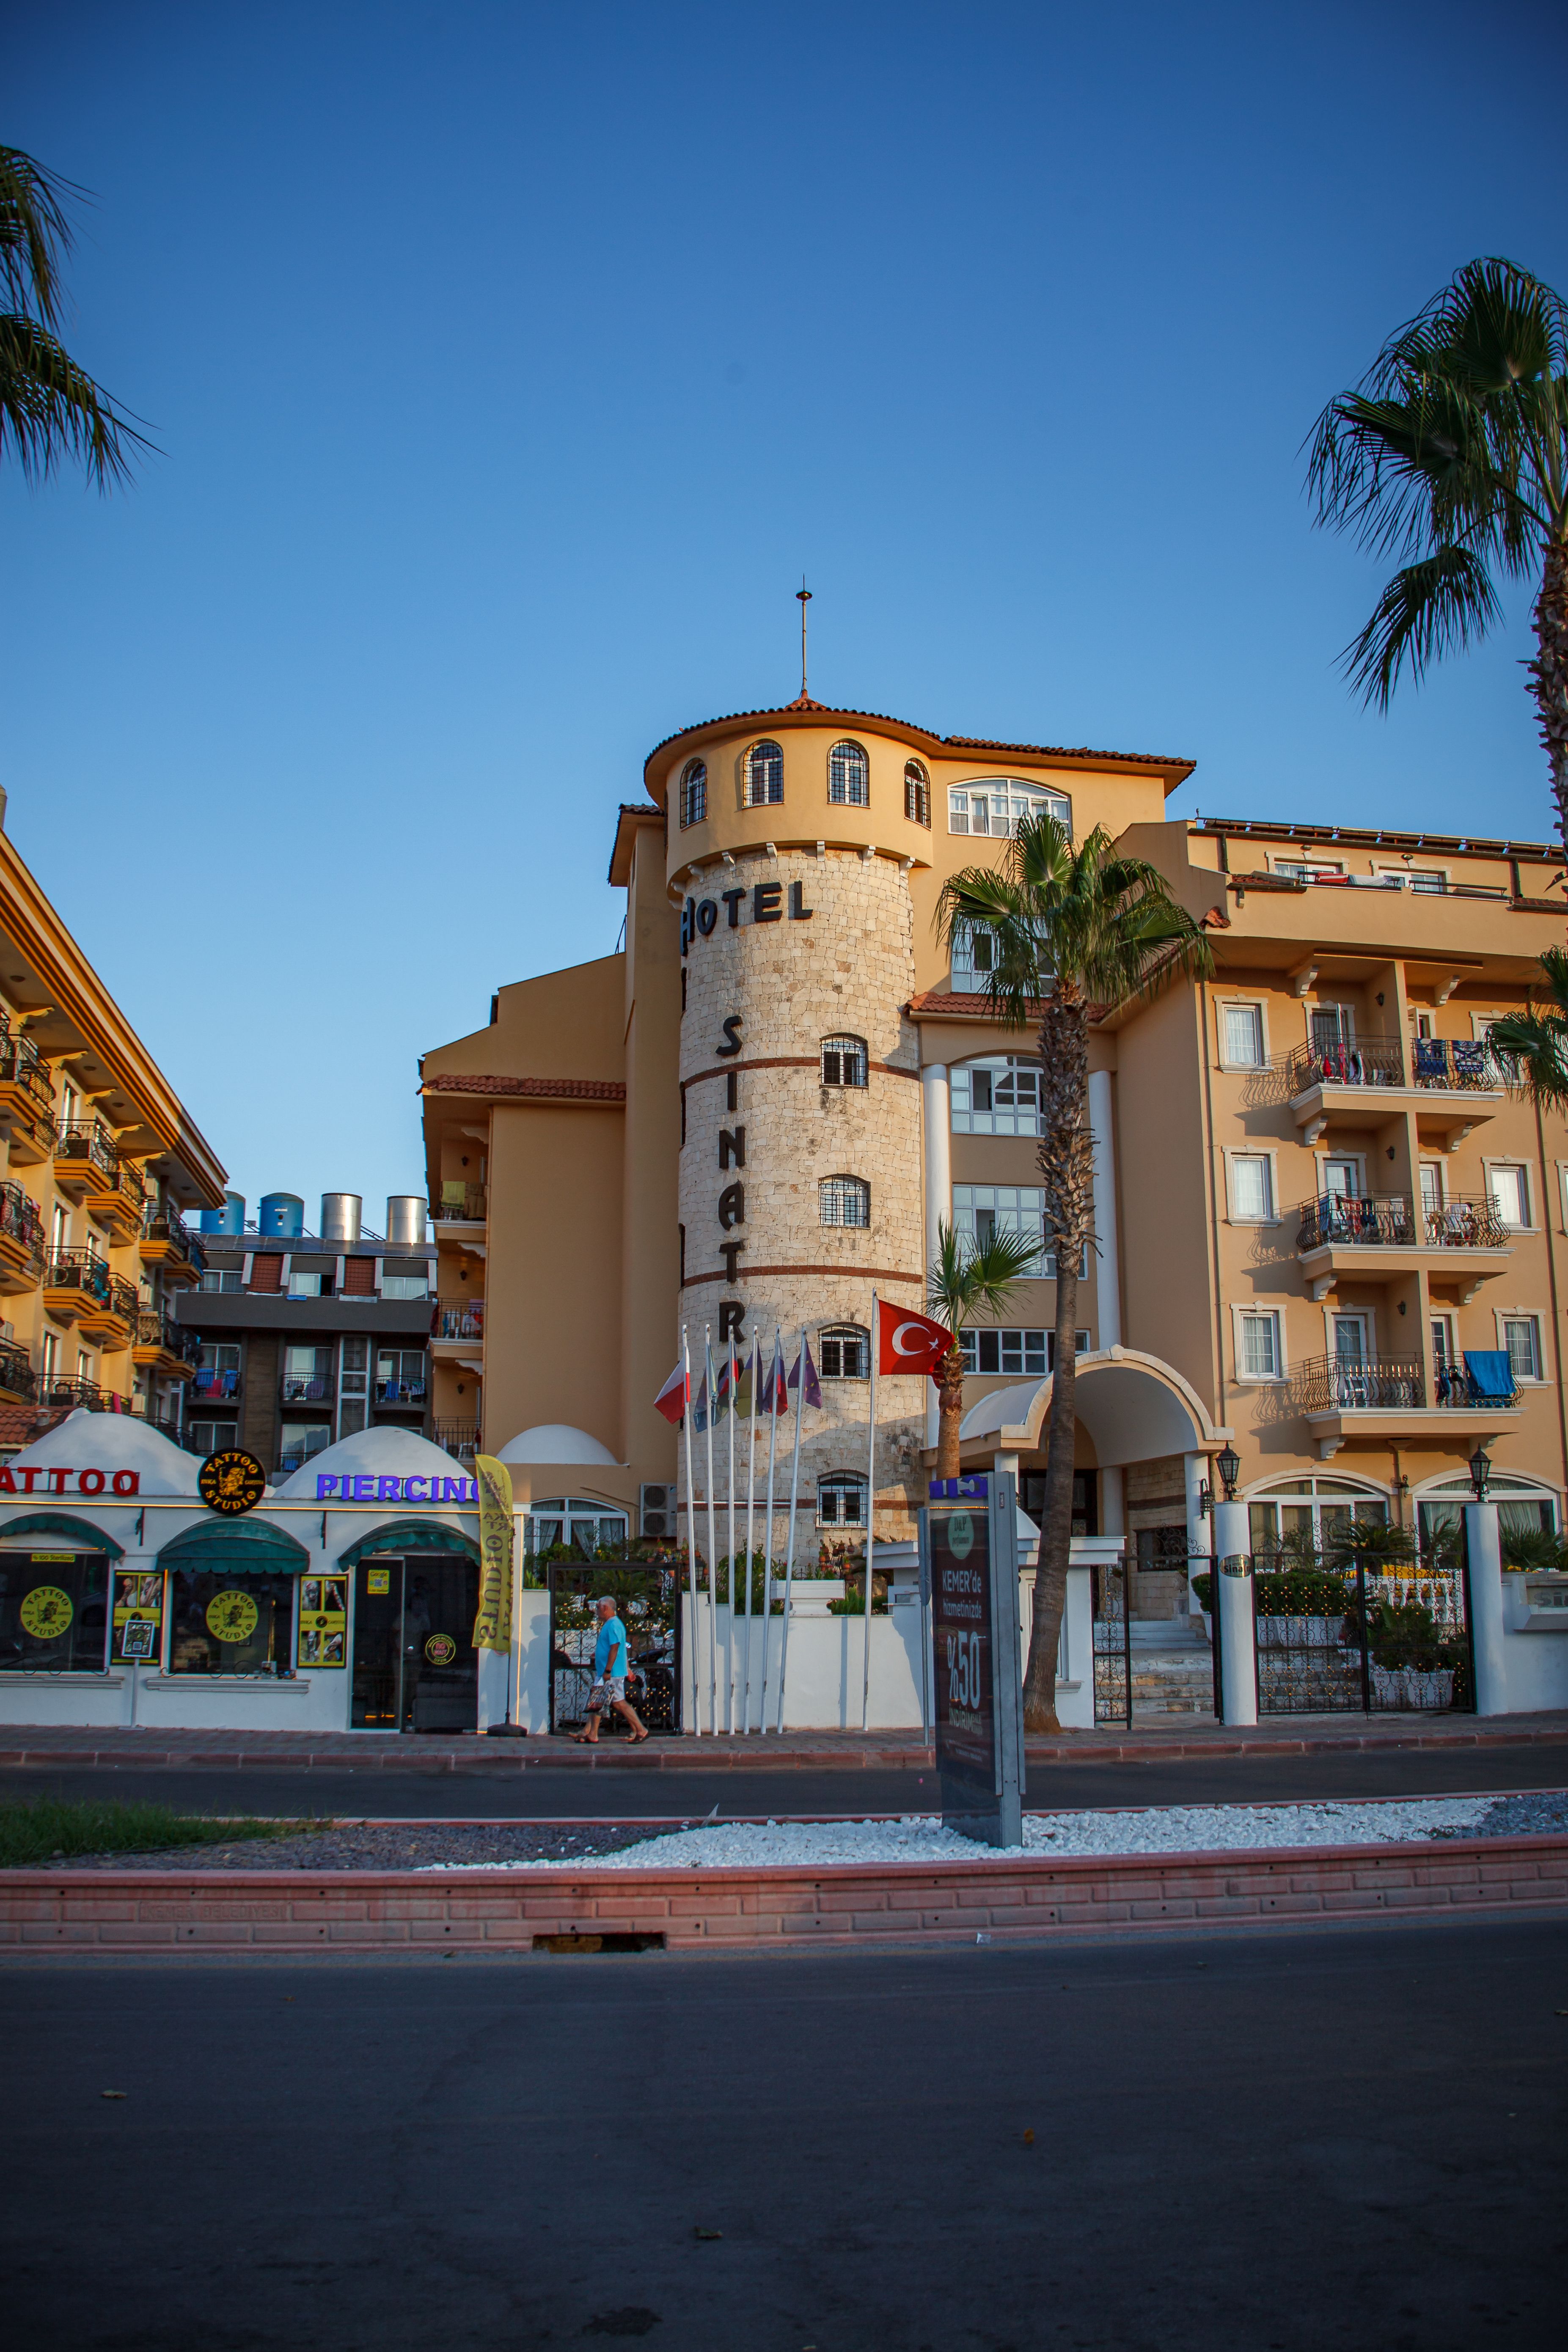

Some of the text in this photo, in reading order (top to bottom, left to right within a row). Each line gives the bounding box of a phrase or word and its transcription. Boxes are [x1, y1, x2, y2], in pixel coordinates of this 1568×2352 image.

[680, 880, 813, 957] HOTEL
[205, 1453, 258, 1474] TATTOO
[0, 1466, 138, 1496] ATTOO
[206, 1490, 256, 1509] STUDIO
[954, 1516, 967, 1532] D&P
[1224, 1564, 1251, 1573] Sinar
[942, 1570, 982, 1593] KEMER'de
[26, 1589, 69, 1606] TATTOO
[212, 1593, 254, 1609] TATTOO
[1534, 1592, 1568, 1606] Si
[943, 1598, 982, 1619] hizmetinizde
[26, 1620, 67, 1636] STUDIO
[212, 1623, 252, 1639] STUDIO
[947, 1631, 981, 1709] %50
